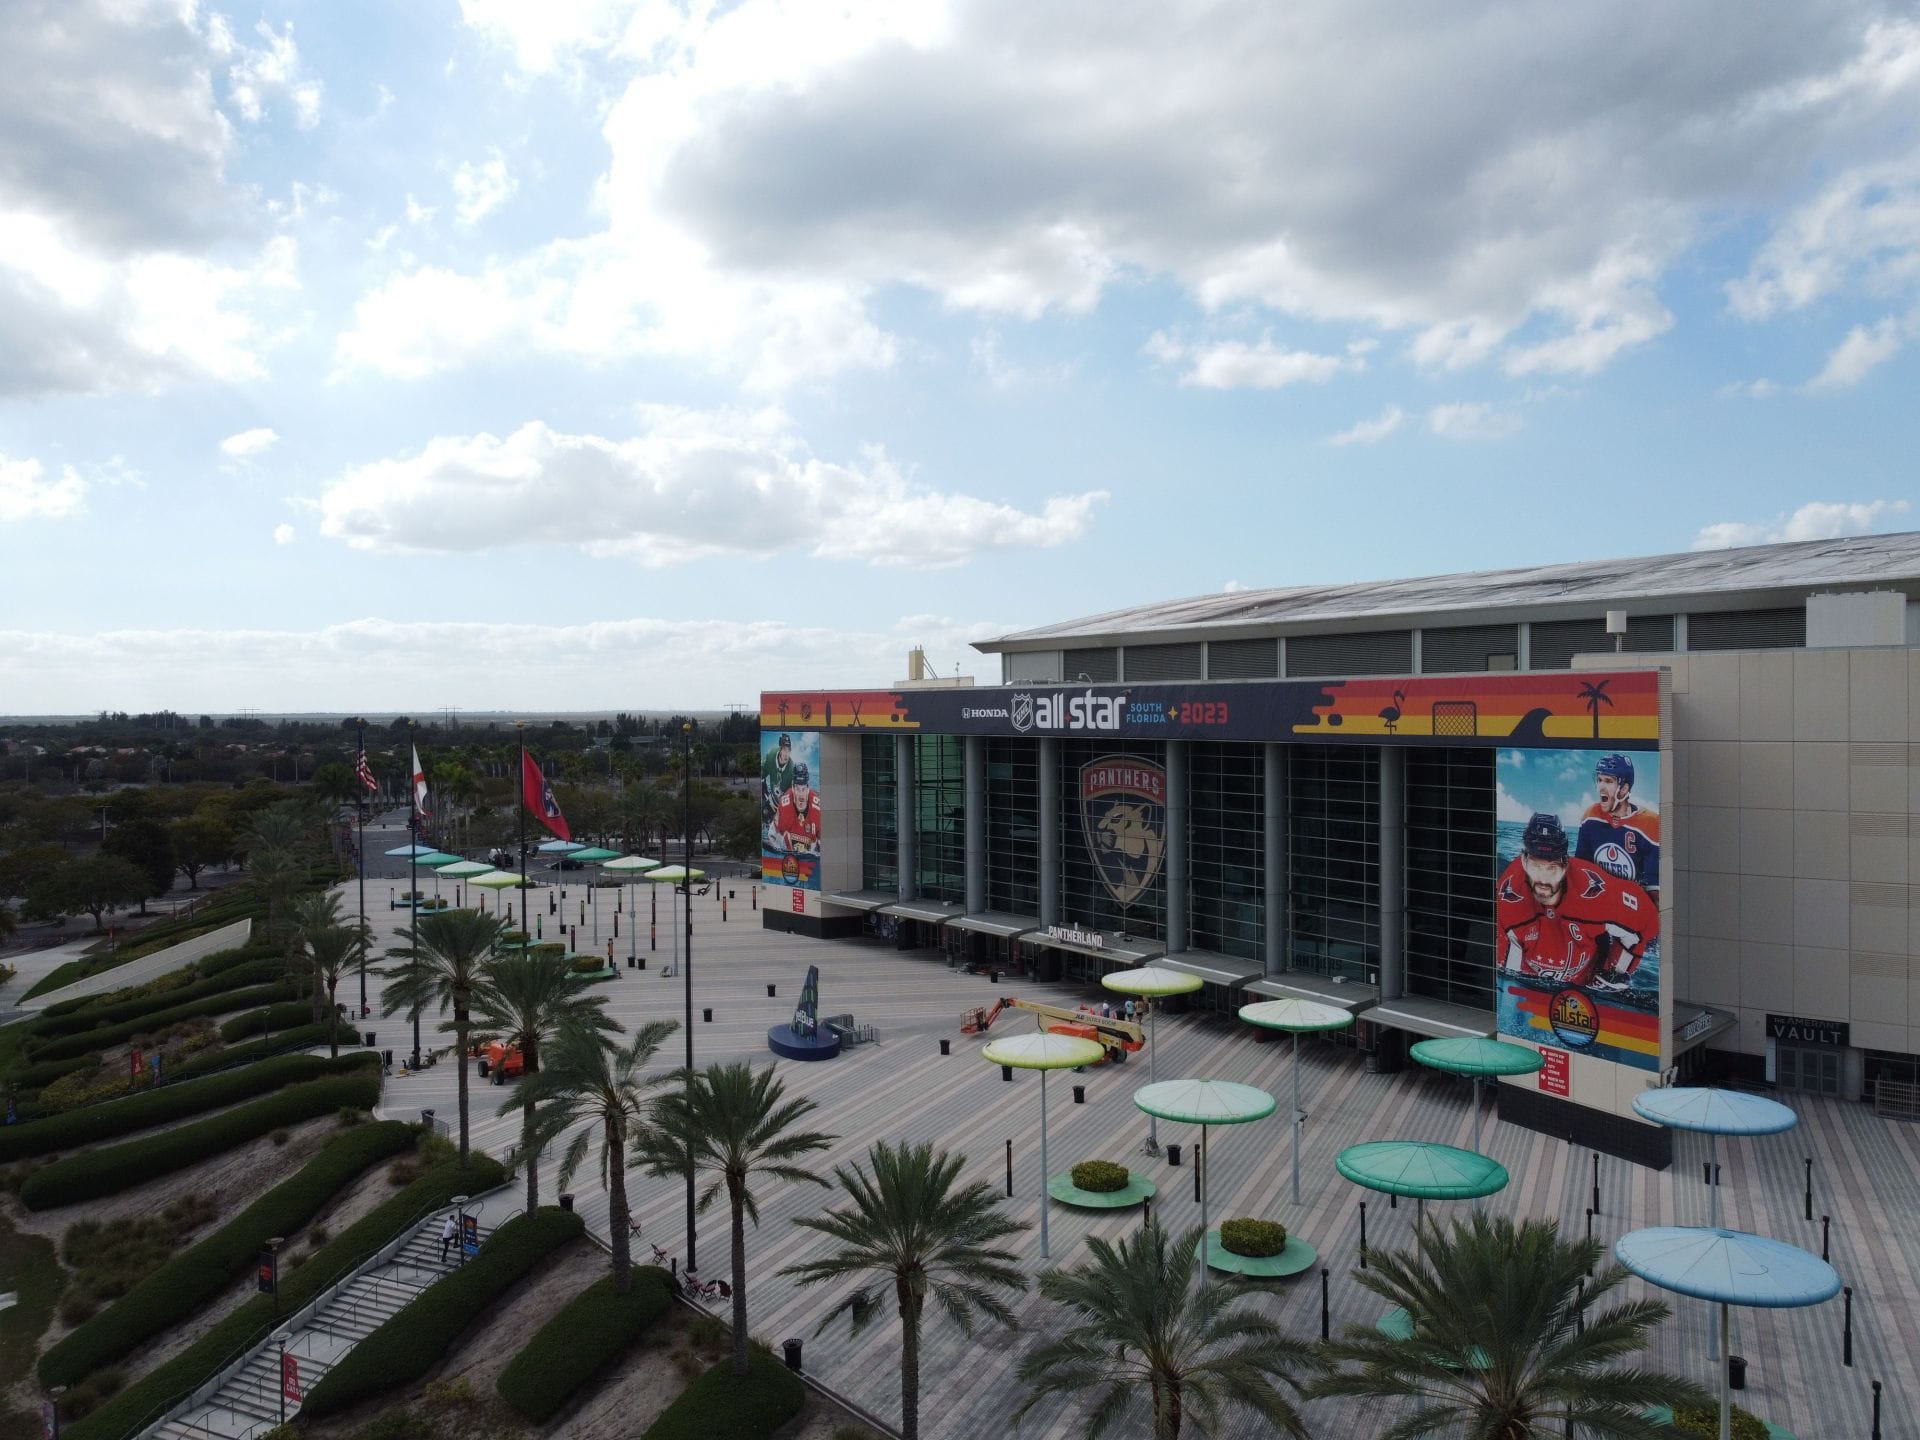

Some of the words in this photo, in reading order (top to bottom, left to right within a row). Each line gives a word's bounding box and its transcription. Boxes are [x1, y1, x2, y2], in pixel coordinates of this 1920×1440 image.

[971, 709, 1009, 718] HONDA
[1069, 688, 1126, 730] star
[1130, 703, 1162, 712] SOUTH
[1181, 702, 1228, 724] 2023
[1126, 714, 1166, 723] FLORIDA
[1090, 768, 1160, 795] PANTHERS
[1624, 831, 1637, 854] C
[1048, 925, 1103, 948] PANTHERLAND
[1568, 923, 1583, 941] C
[1774, 1024, 1842, 1045] VAULT
